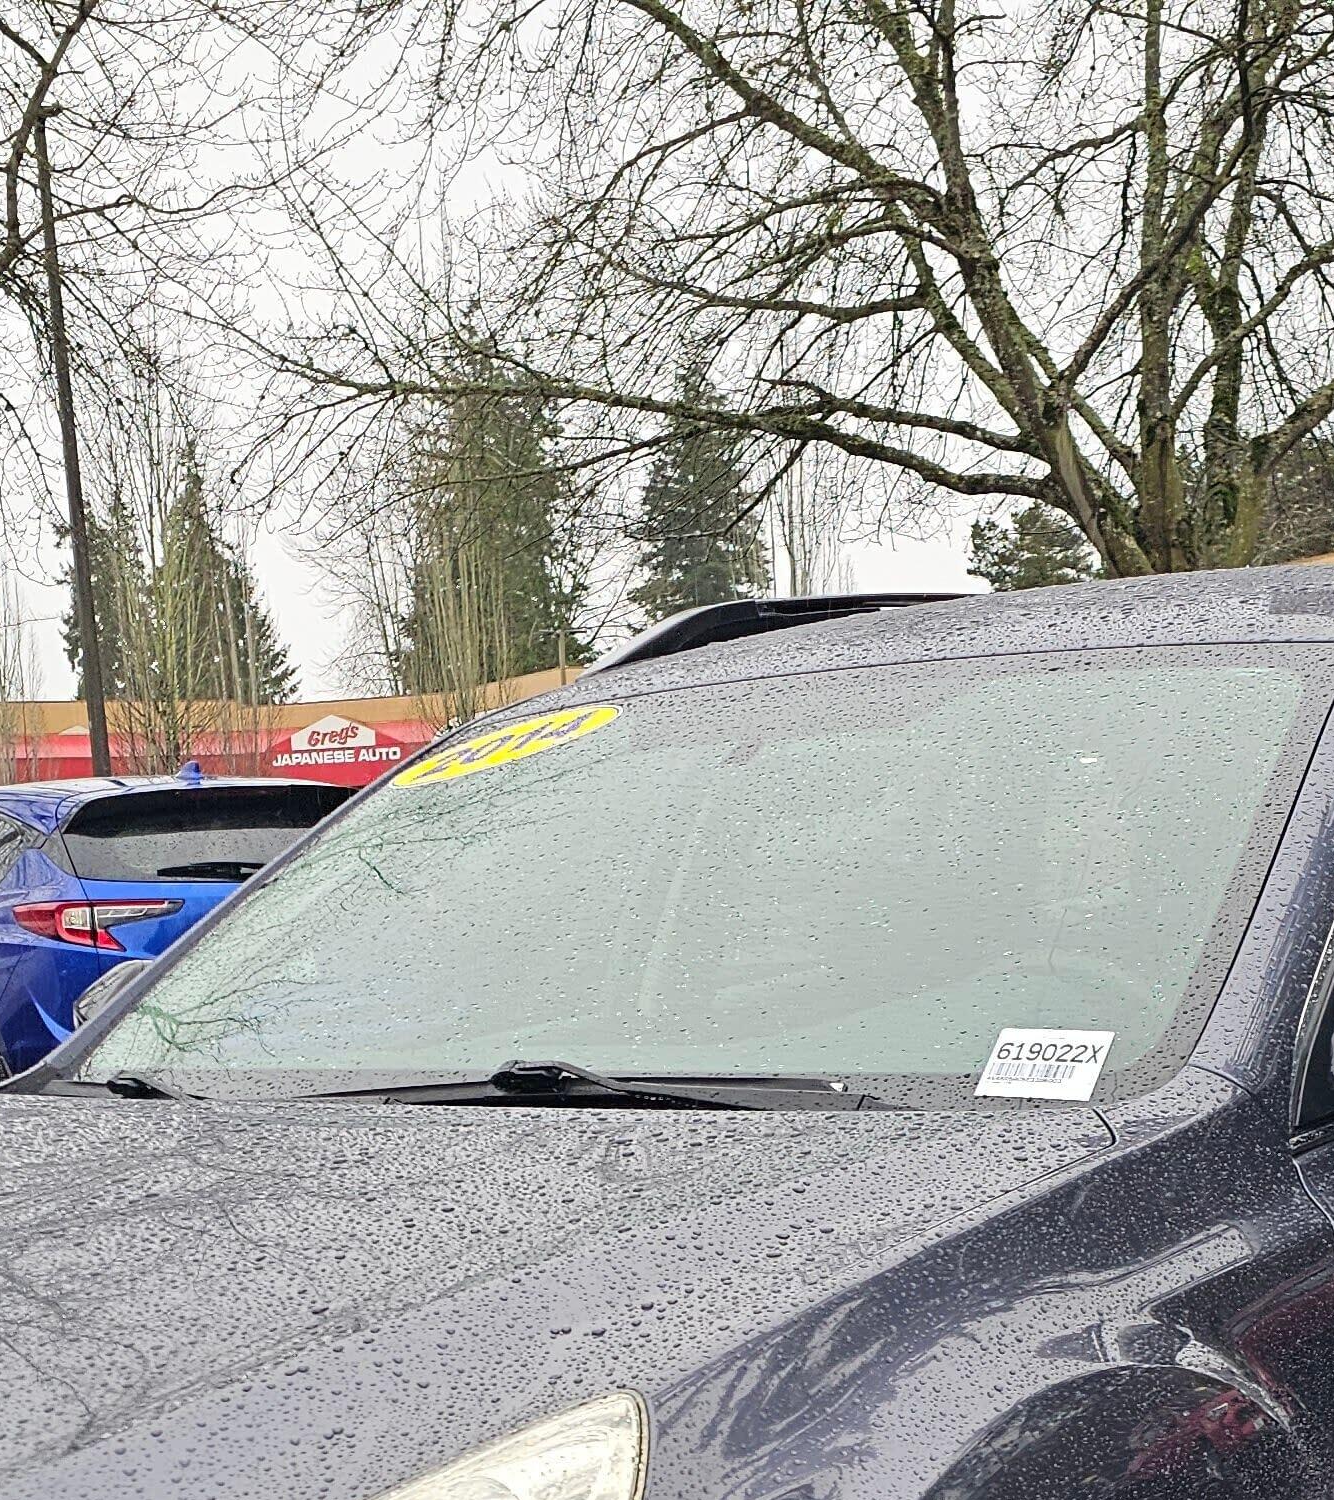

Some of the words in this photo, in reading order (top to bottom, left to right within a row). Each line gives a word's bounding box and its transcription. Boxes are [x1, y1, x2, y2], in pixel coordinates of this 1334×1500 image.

[307, 722, 359, 747] Greg's
[272, 750, 356, 767] JAPANESE
[358, 746, 401, 762] AUTO
[997, 1042, 1105, 1063] 619022X
